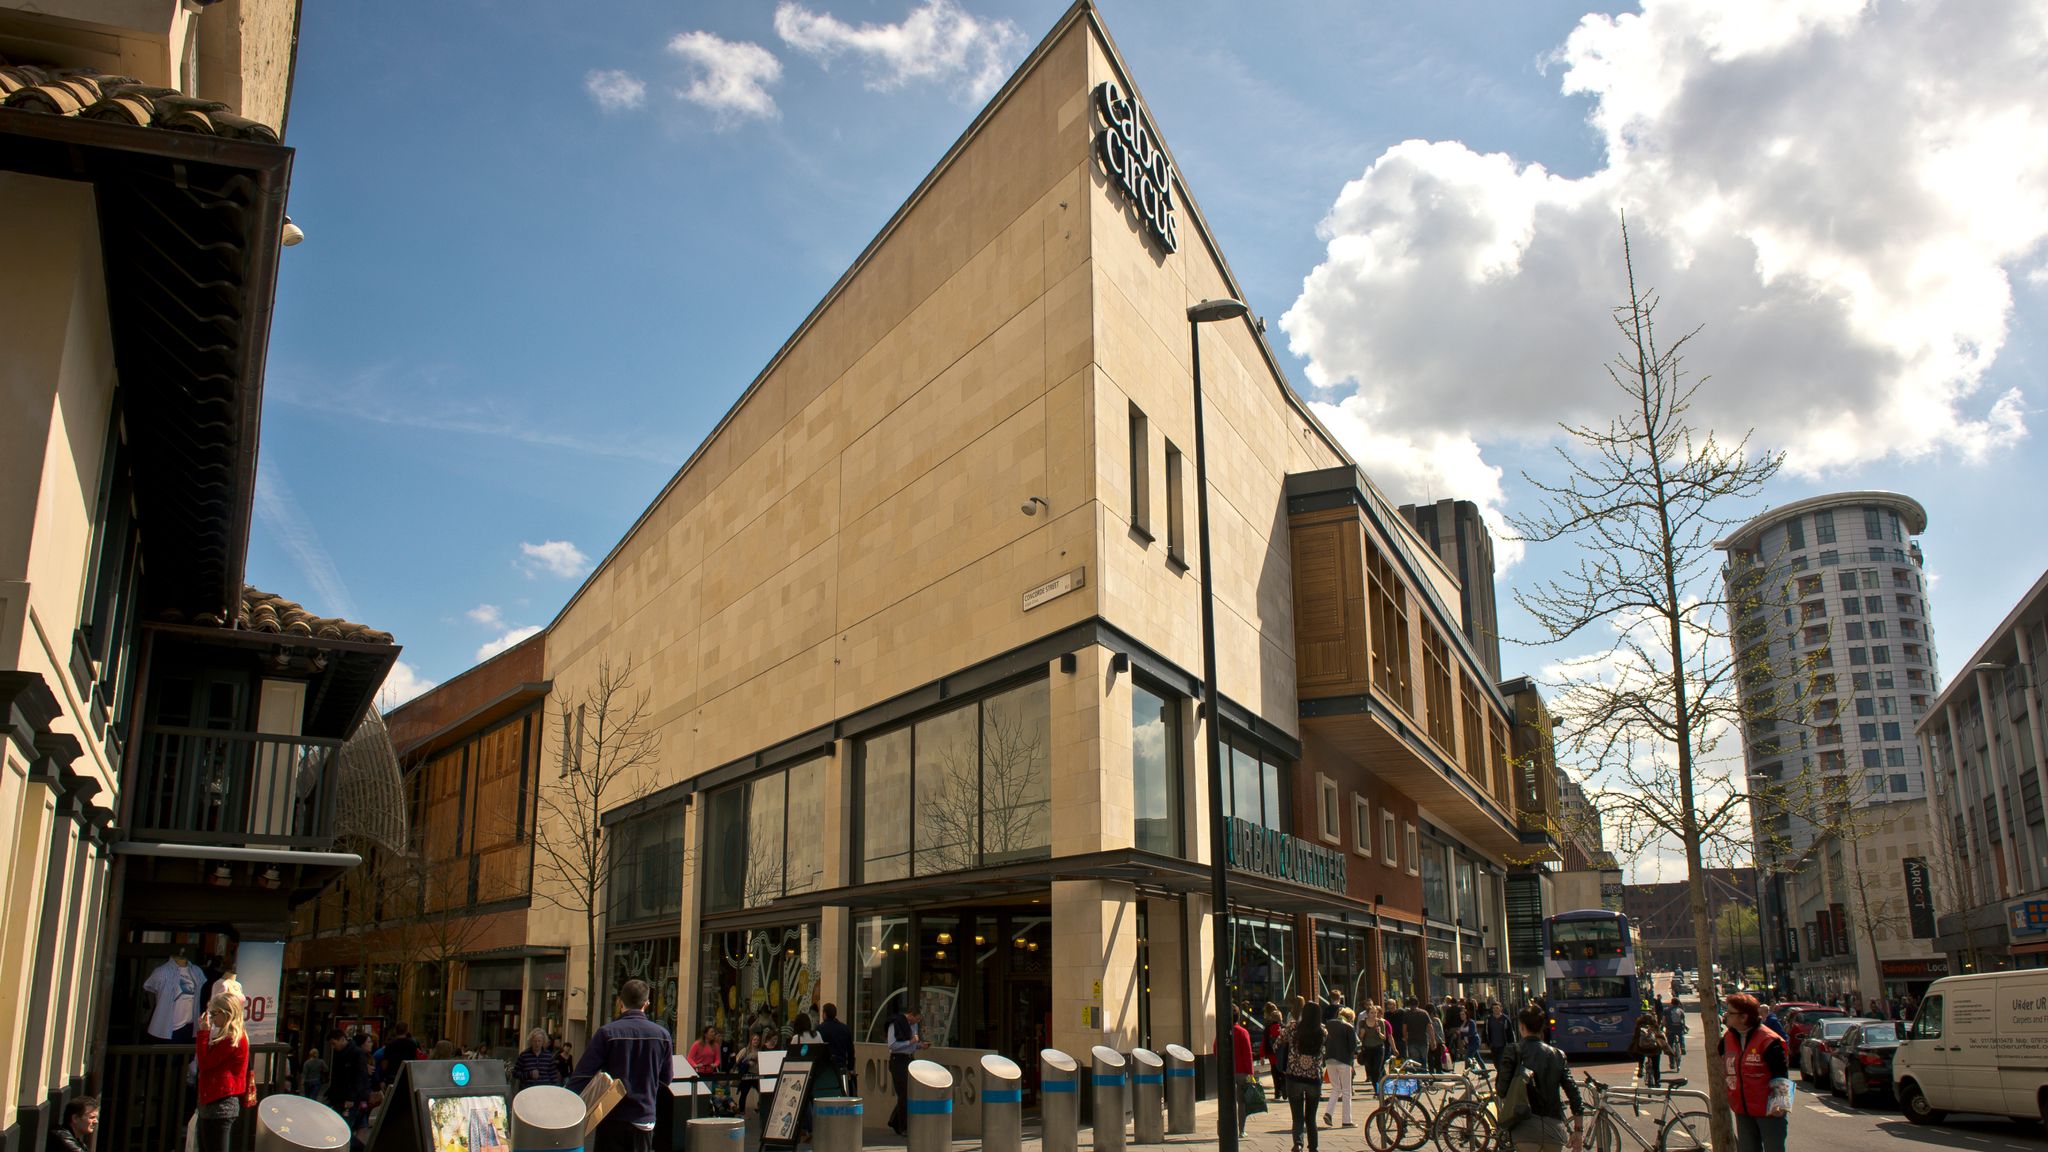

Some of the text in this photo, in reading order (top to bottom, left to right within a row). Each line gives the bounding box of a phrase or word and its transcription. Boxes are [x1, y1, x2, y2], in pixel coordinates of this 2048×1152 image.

[1025, 588, 1044, 602] CONCORDE
[1226, 815, 1347, 895] URBAN OUTFITTERS
[1909, 862, 1926, 909] APRICOT
[1927, 962, 1948, 972] Loca
